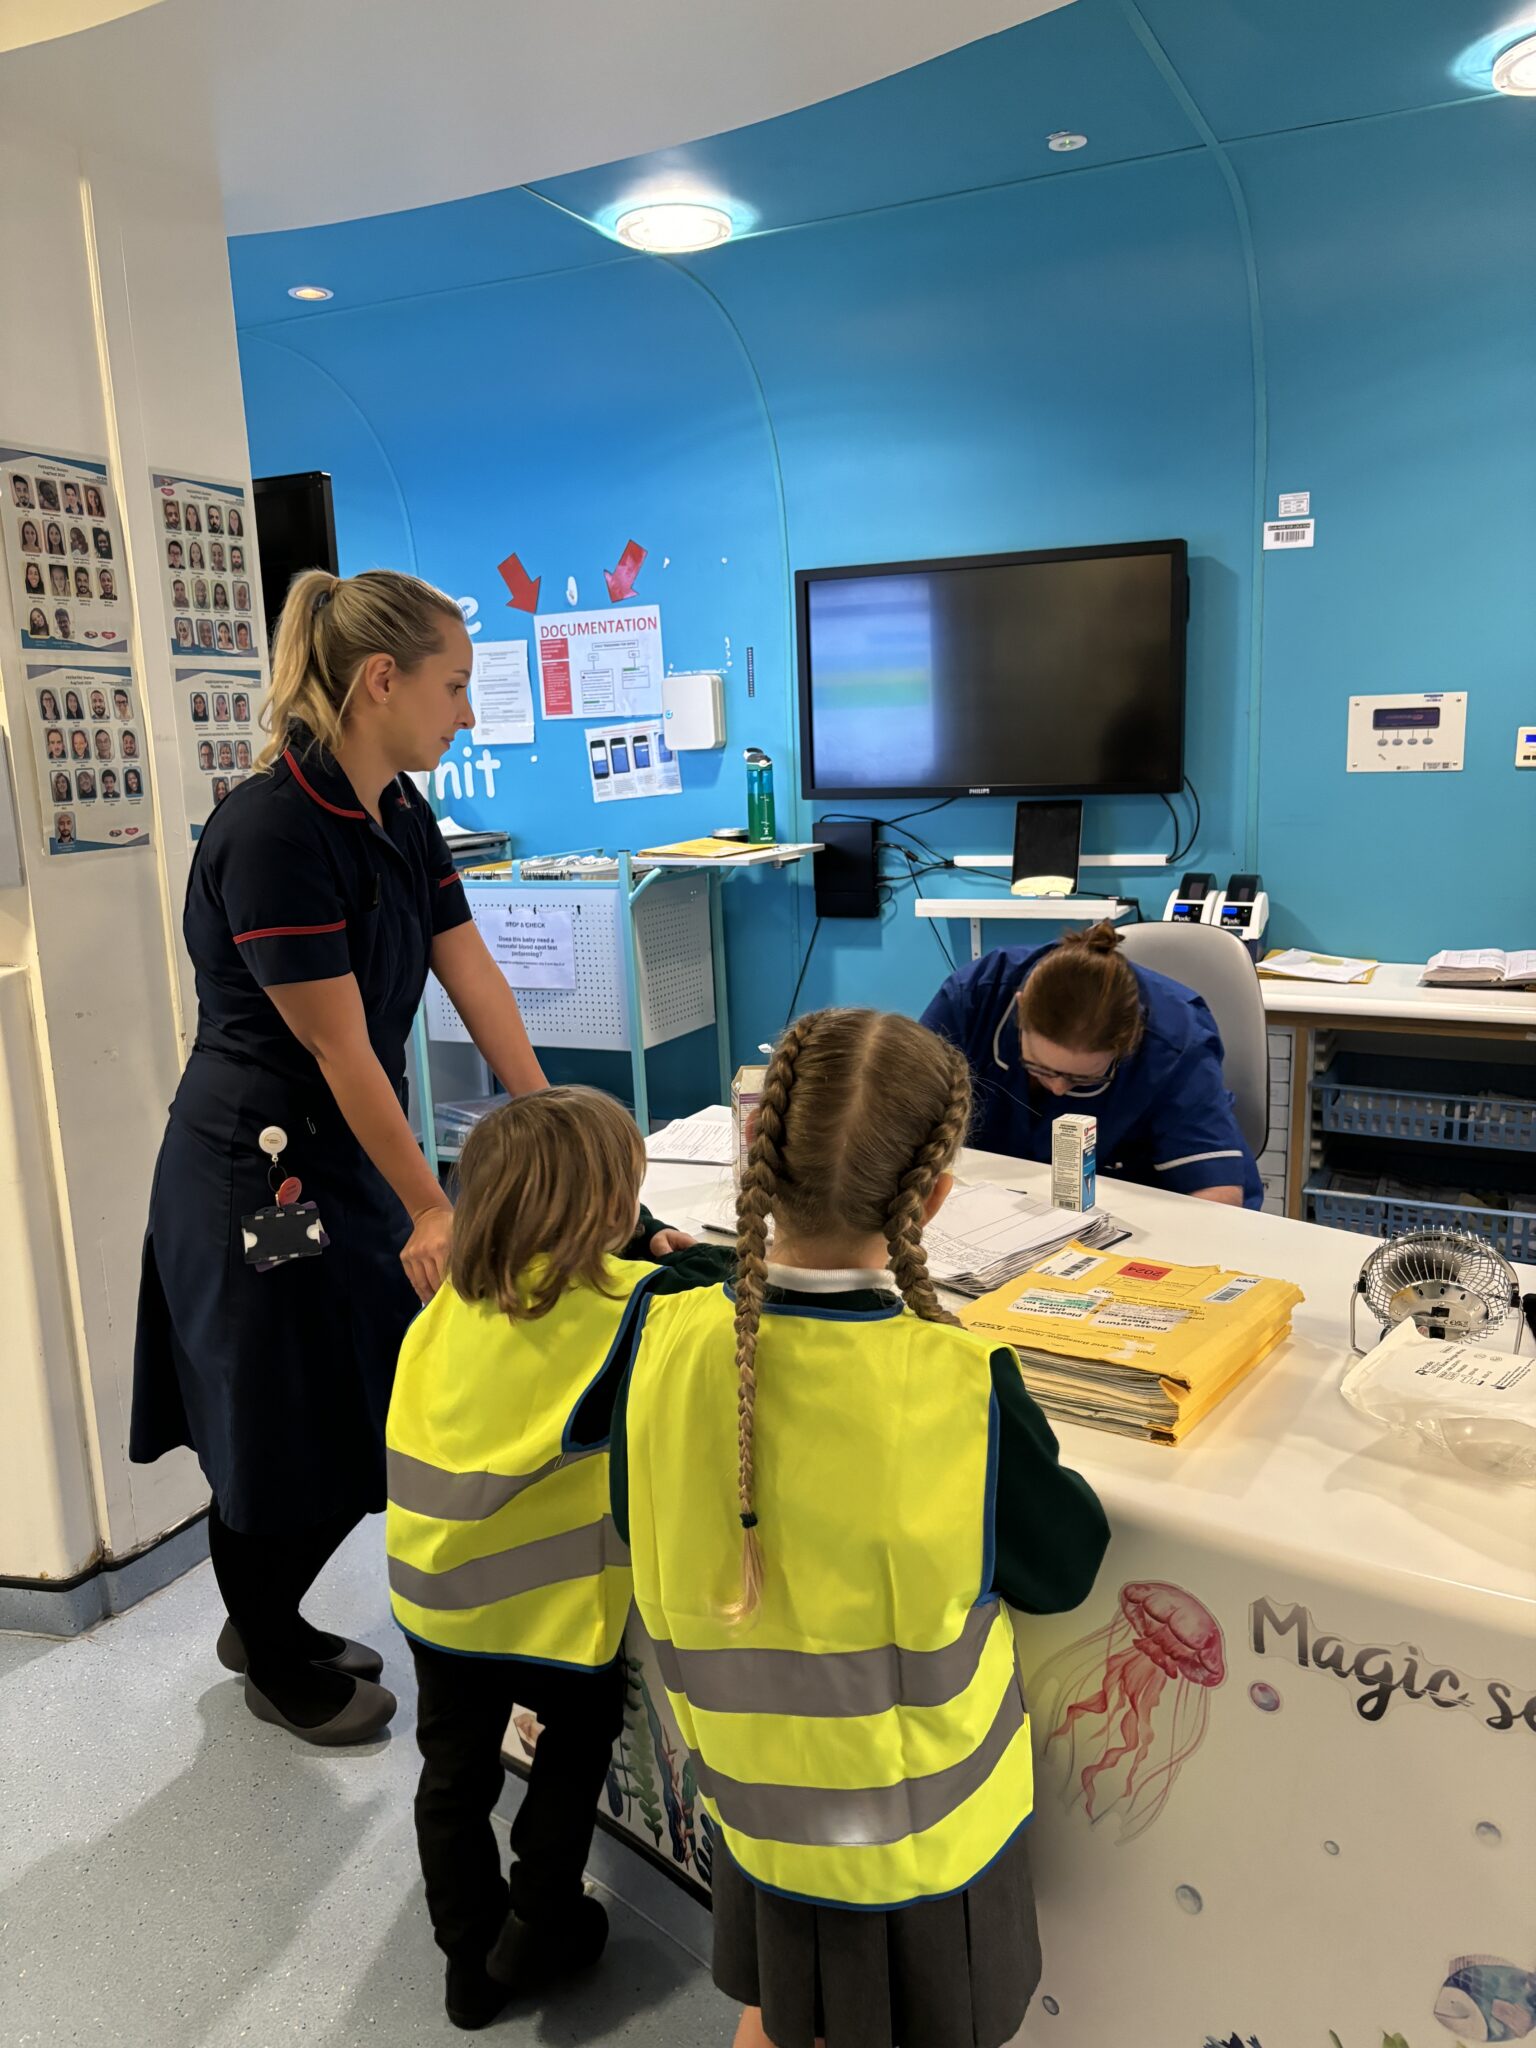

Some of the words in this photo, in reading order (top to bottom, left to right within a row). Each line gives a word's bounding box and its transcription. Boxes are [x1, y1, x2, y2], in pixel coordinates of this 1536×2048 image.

[540, 616, 657, 638] DOCUMENTATION
[434, 746, 501, 800] nit
[522, 936, 536, 944] baby
[1128, 1266, 1163, 1277] 2024
[1016, 1306, 1048, 1314] return
[1098, 1319, 1132, 1327] return
[1121, 1317, 1150, 1325] these
[1253, 1596, 1470, 1721] Magic
